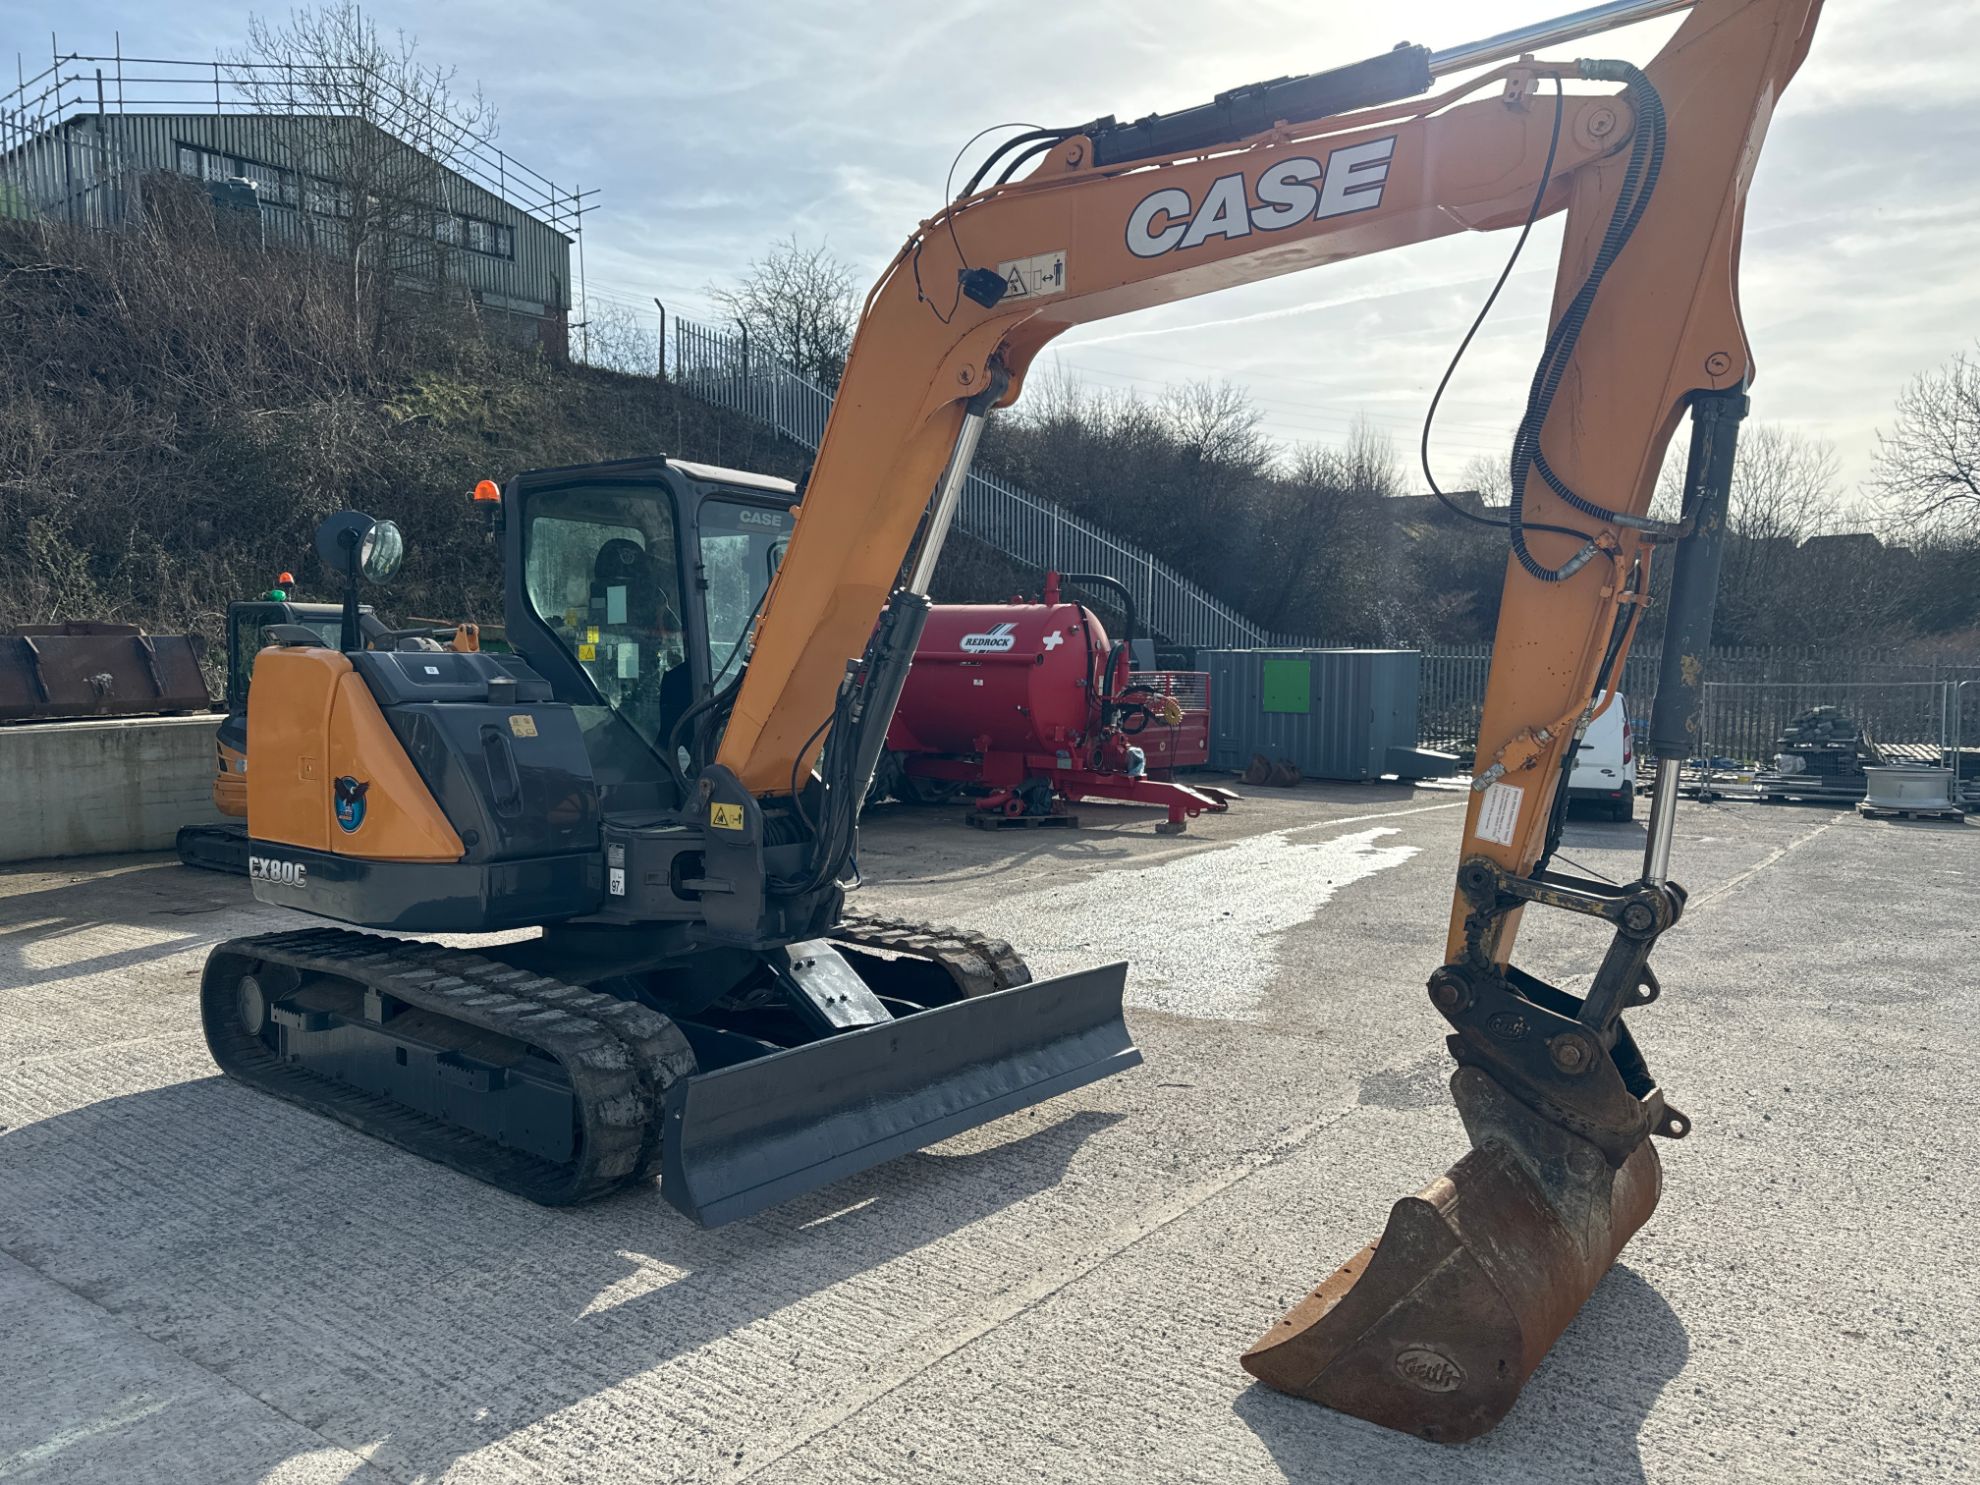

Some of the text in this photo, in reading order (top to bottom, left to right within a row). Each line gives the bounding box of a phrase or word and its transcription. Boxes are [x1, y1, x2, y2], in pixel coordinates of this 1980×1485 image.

[1125, 134, 1398, 258] CASE
[739, 510, 782, 527] CASE
[964, 637, 1011, 647] REDROCK
[248, 855, 307, 887] CX80C
